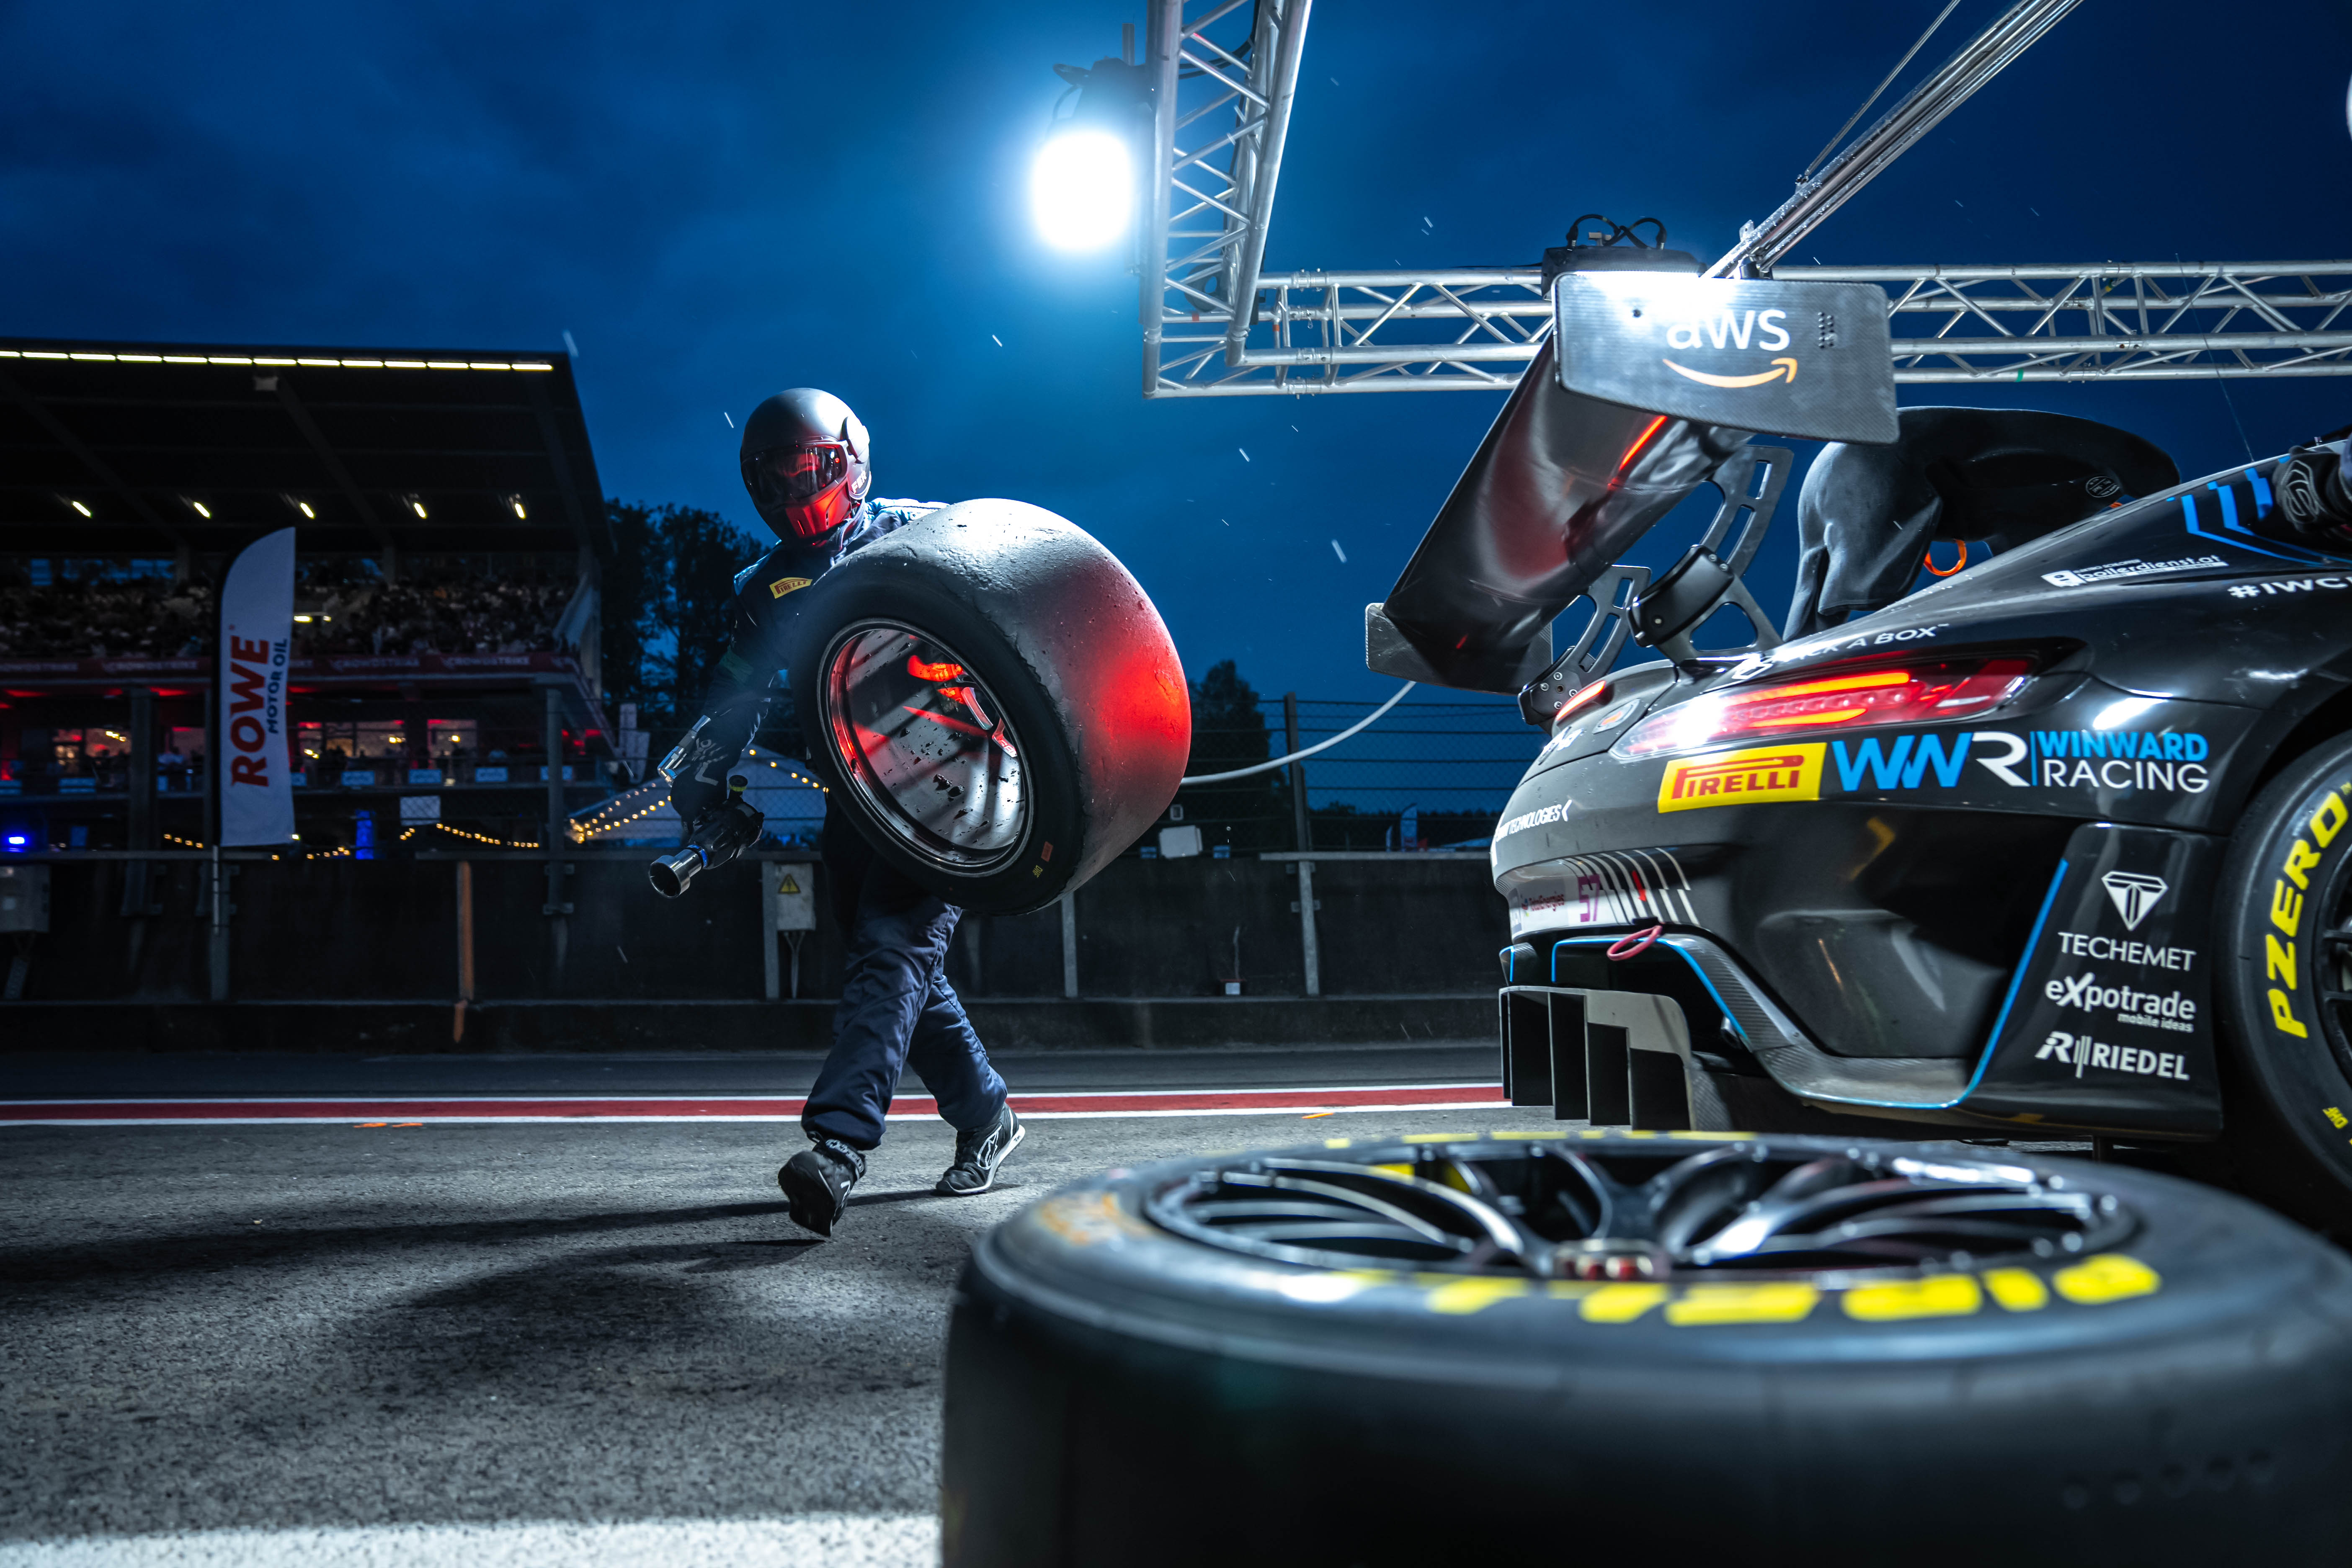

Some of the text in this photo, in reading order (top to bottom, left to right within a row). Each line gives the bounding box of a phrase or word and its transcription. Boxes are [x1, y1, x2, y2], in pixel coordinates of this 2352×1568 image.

[1666, 309, 1790, 351] aws
[774, 579, 808, 594] PIRELLI
[2076, 555, 2222, 579] boilerdienst.at
[1847, 638, 1867, 649] A
[267, 638, 288, 734] MOTOR OIL
[230, 635, 269, 787] ROWE
[2036, 730, 2209, 762] WINWARD
[1671, 755, 1804, 799] PIRELLI
[2043, 759, 2210, 793] RACING
[1509, 804, 1562, 835] TECHNOLOGIES
[1578, 874, 1600, 923] 57
[2058, 932, 2197, 972] TECHEMET
[2045, 972, 2197, 1020] eXpotrade
[2117, 1013, 2194, 1033] mobile ideas
[2091, 1042, 2190, 1081] RIEDEL
